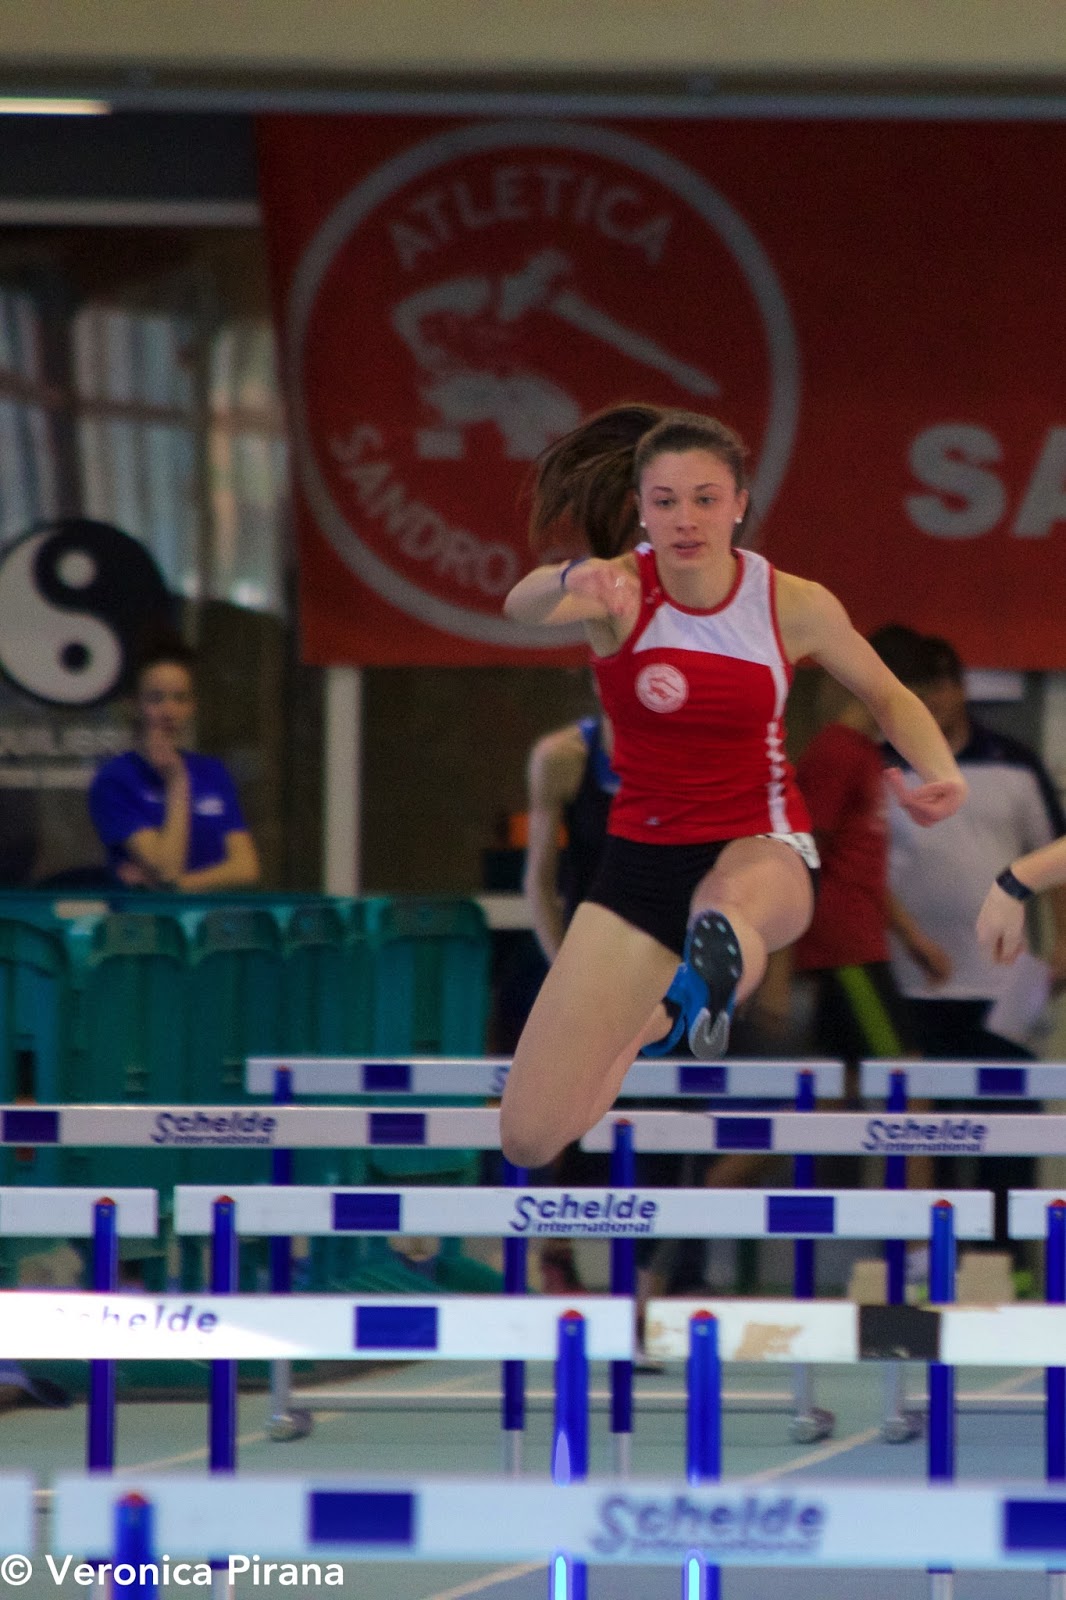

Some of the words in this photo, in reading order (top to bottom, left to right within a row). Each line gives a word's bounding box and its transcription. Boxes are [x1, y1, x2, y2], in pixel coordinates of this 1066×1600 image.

[389, 164, 673, 272] ATLETICA
[328, 423, 519, 596] SANDRO
[151, 1111, 277, 1144] Schelde
[862, 1119, 988, 1151] Schelde
[510, 1193, 656, 1232] Schelde
[56, 1304, 218, 1333] helde
[589, 1494, 824, 1552] Schelde
